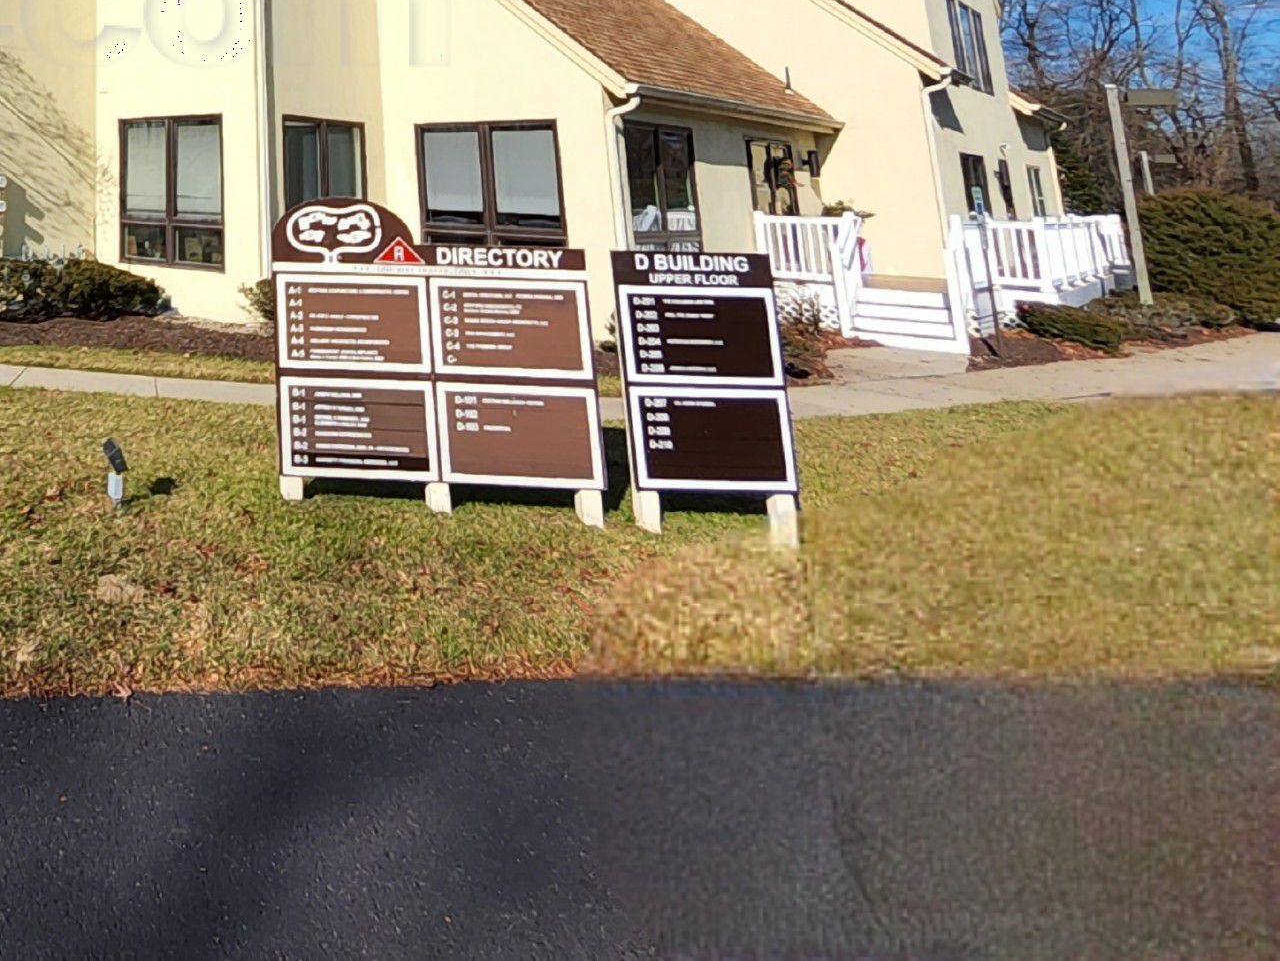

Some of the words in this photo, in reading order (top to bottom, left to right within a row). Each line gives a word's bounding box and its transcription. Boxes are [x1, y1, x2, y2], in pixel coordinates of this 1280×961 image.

[436, 247, 563, 268] DIRECTORY
[634, 253, 649, 270] D
[654, 254, 750, 273] BUILDING
[649, 273, 693, 285] UPPER
[694, 274, 739, 286] FLOOR
